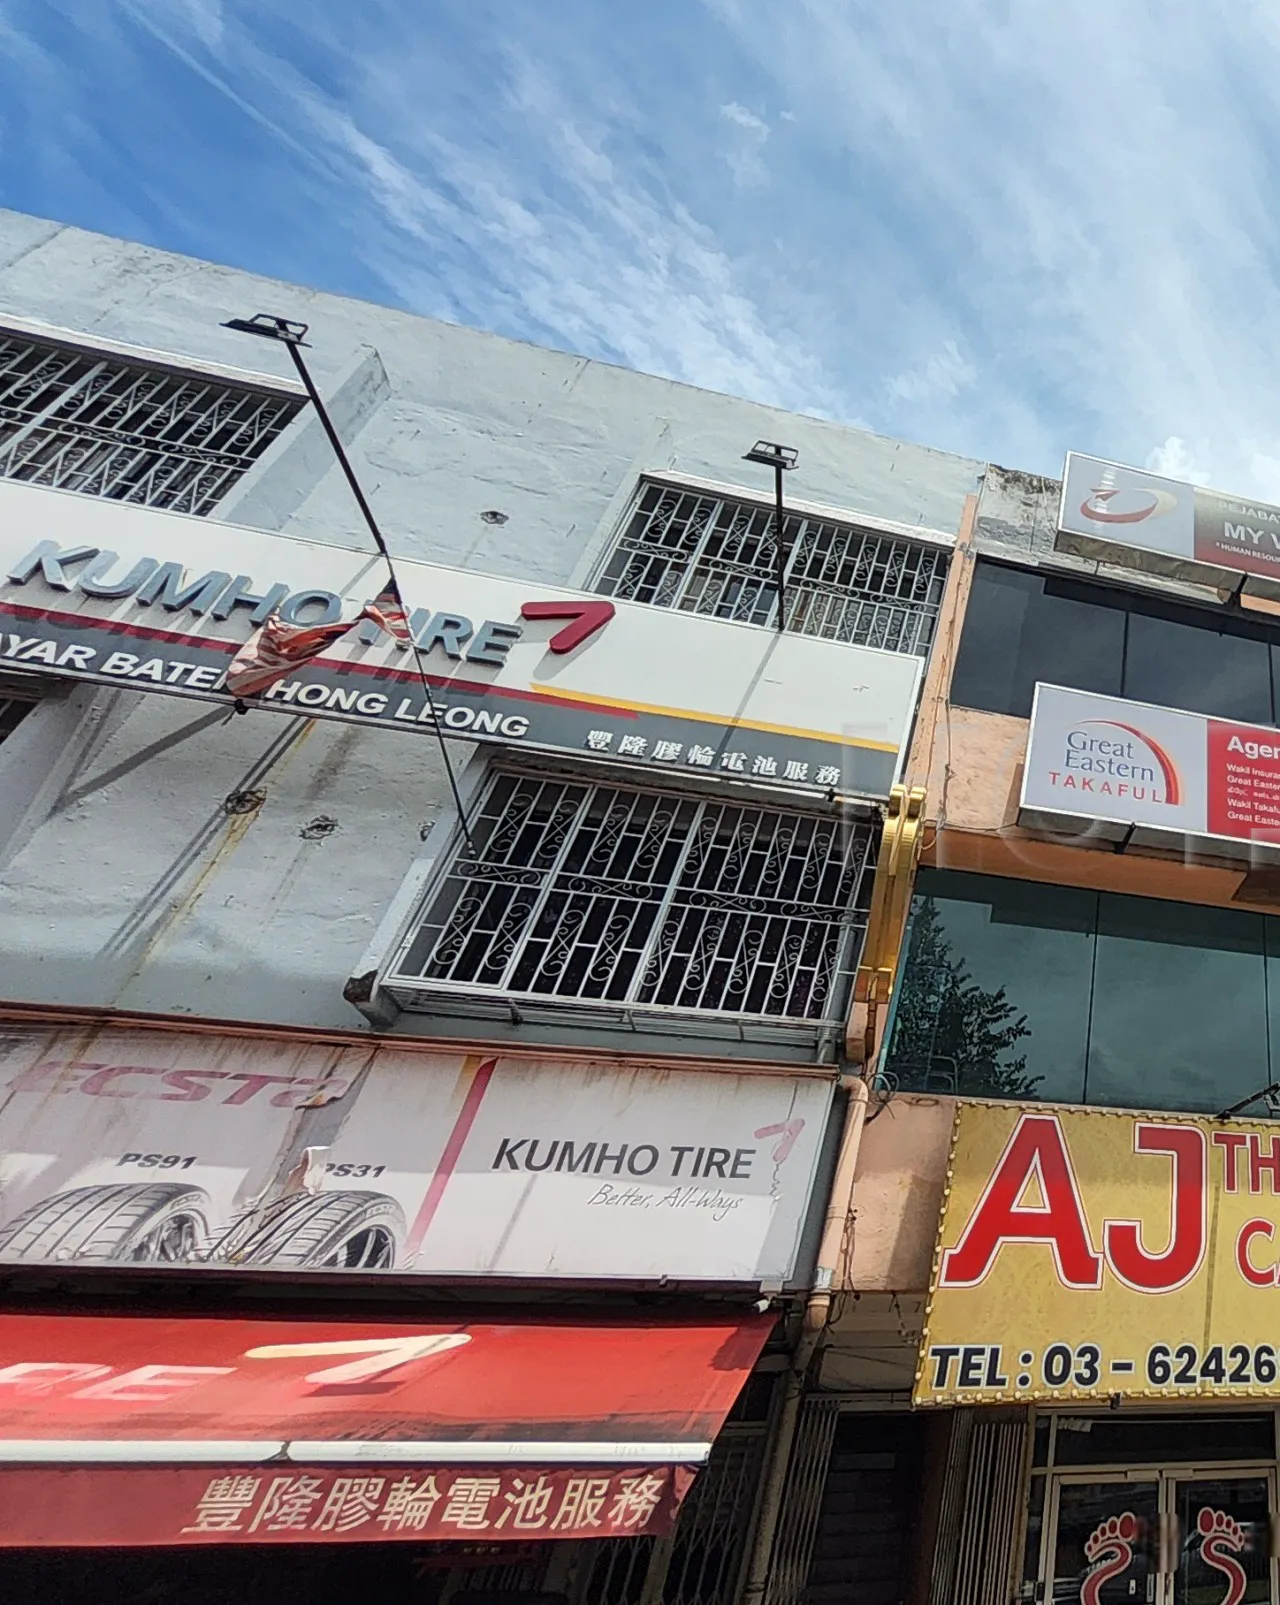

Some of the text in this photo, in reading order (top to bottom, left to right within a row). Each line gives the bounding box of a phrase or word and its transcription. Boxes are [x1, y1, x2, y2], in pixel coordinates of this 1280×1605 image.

[1224, 521, 1264, 545] MY
[1221, 544, 1252, 556] HUMAN
[7, 540, 343, 628] KUMHO
[265, 679, 389, 714] HONG
[394, 698, 531, 737] LEONG
[1067, 731, 1134, 759] Great
[1065, 749, 1154, 782] Eastern
[1226, 763, 1251, 775] Wakil
[1048, 771, 1163, 803] TAKAFUL
[1227, 775, 1252, 786] Great
[1227, 798, 1252, 809] Wakil
[1227, 811, 1253, 823] Great
[116, 1153, 198, 1171] PS91
[491, 1137, 757, 1179] KUMHO TIRE
[587, 1183, 651, 1209] Better,
[939, 1113, 1208, 1295] AJ
[1042, 1342, 1102, 1388] 03
[180, 1473, 669, 1535] 豐隆膠輪電池服務
